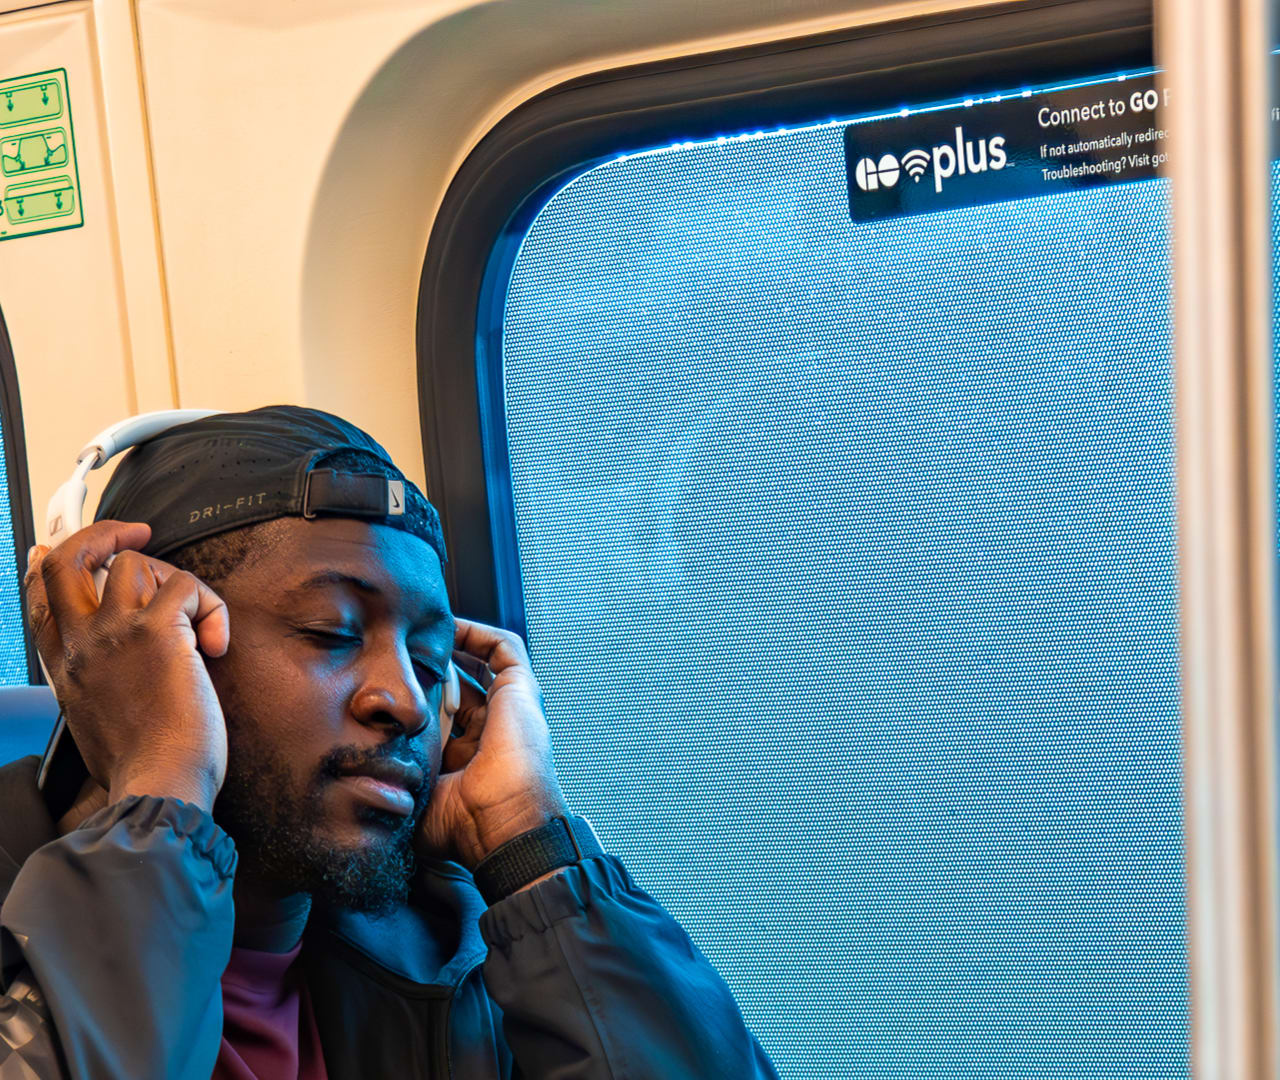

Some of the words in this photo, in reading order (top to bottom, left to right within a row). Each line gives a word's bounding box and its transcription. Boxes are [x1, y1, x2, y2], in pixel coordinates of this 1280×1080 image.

[1037, 101, 1106, 128] Connect
[1108, 99, 1126, 117] to
[1130, 89, 1158, 113] GO
[932, 126, 1007, 193] plus
[1040, 144, 1048, 159] If
[1049, 144, 1066, 157] not
[1067, 131, 1133, 154] automatically
[1041, 156, 1127, 181] Troubleshooting?
[1128, 153, 1150, 168] Visit
[189, 492, 267, 524] DRI-FIT
